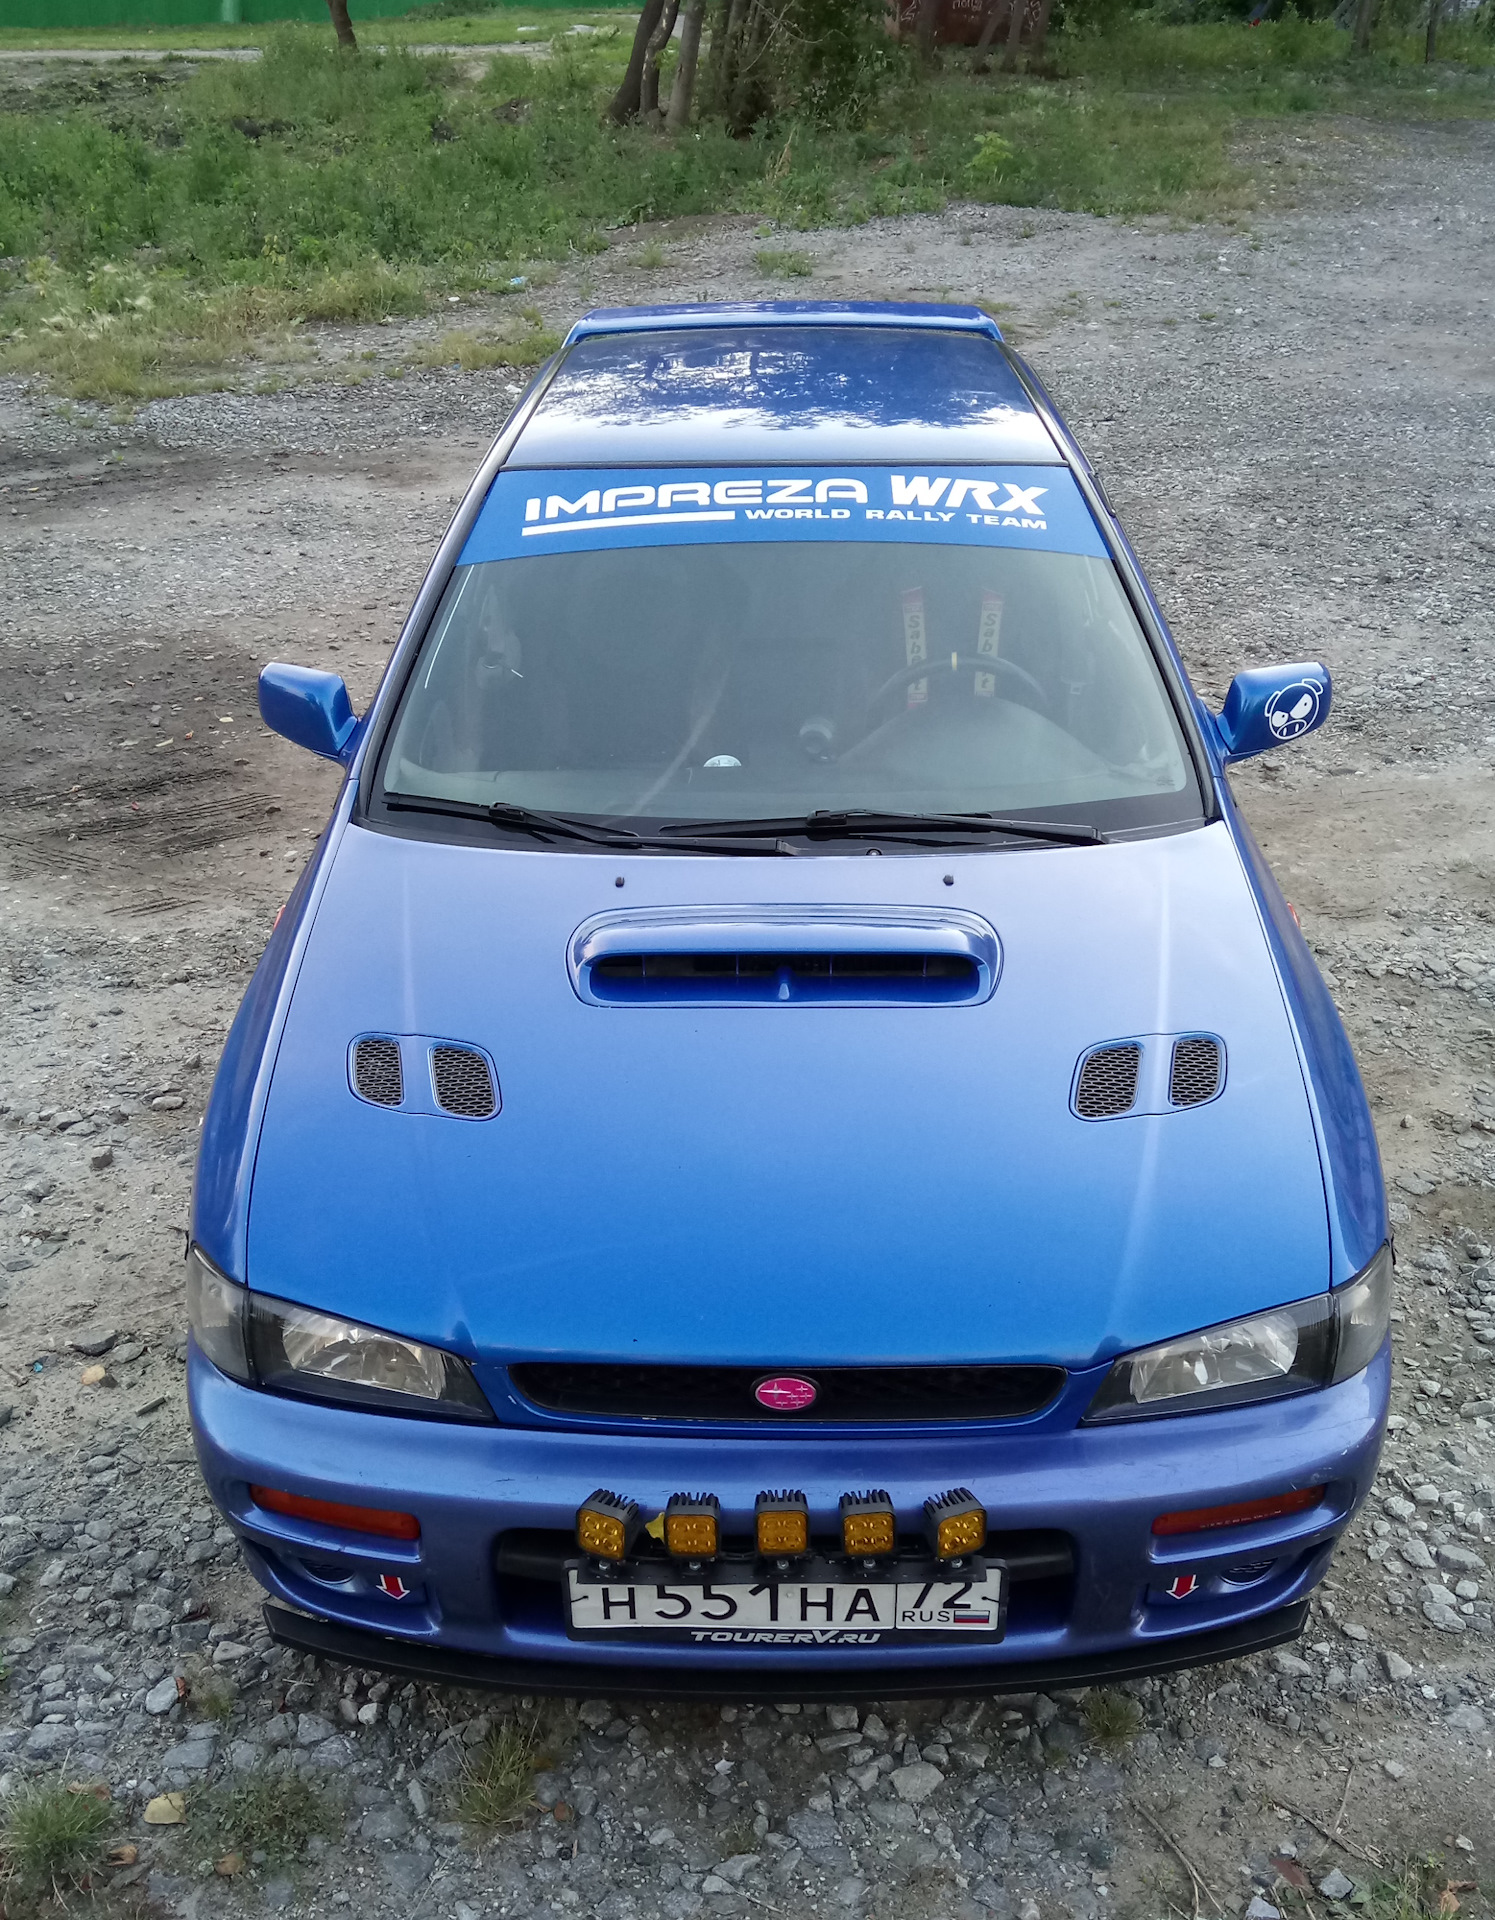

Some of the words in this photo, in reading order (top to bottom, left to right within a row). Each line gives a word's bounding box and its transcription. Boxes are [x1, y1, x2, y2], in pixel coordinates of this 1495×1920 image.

[524, 478, 868, 521] IMPREZA
[890, 474, 1049, 515] WRX
[744, 508, 851, 520] WORLD
[865, 509, 955, 522] RALLY
[965, 513, 1048, 531] TEAM
[907, 614, 922, 691] Sabet
[902, 1610, 950, 1623] RUS
[690, 1630, 881, 1643] TOURERV.RU
